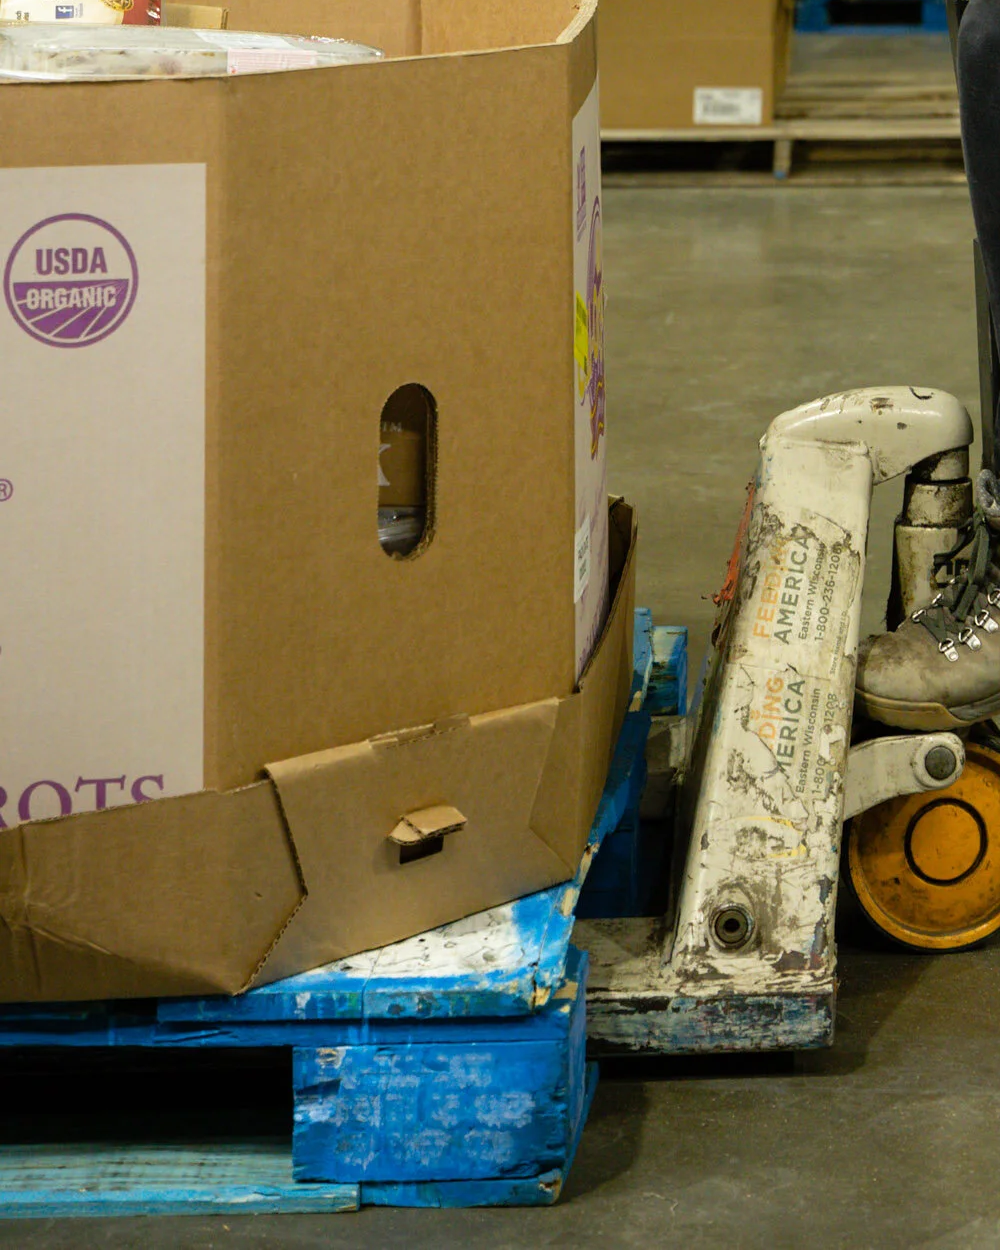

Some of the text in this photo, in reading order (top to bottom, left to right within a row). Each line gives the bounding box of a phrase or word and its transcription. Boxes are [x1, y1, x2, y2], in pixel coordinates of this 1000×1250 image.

[36, 247, 108, 276] USDA
[26, 285, 117, 310] ORGANIC
[798, 599, 815, 640] Eastern
[777, 680, 806, 774] MERICA
[795, 688, 821, 794] Eastern Wisconsin
